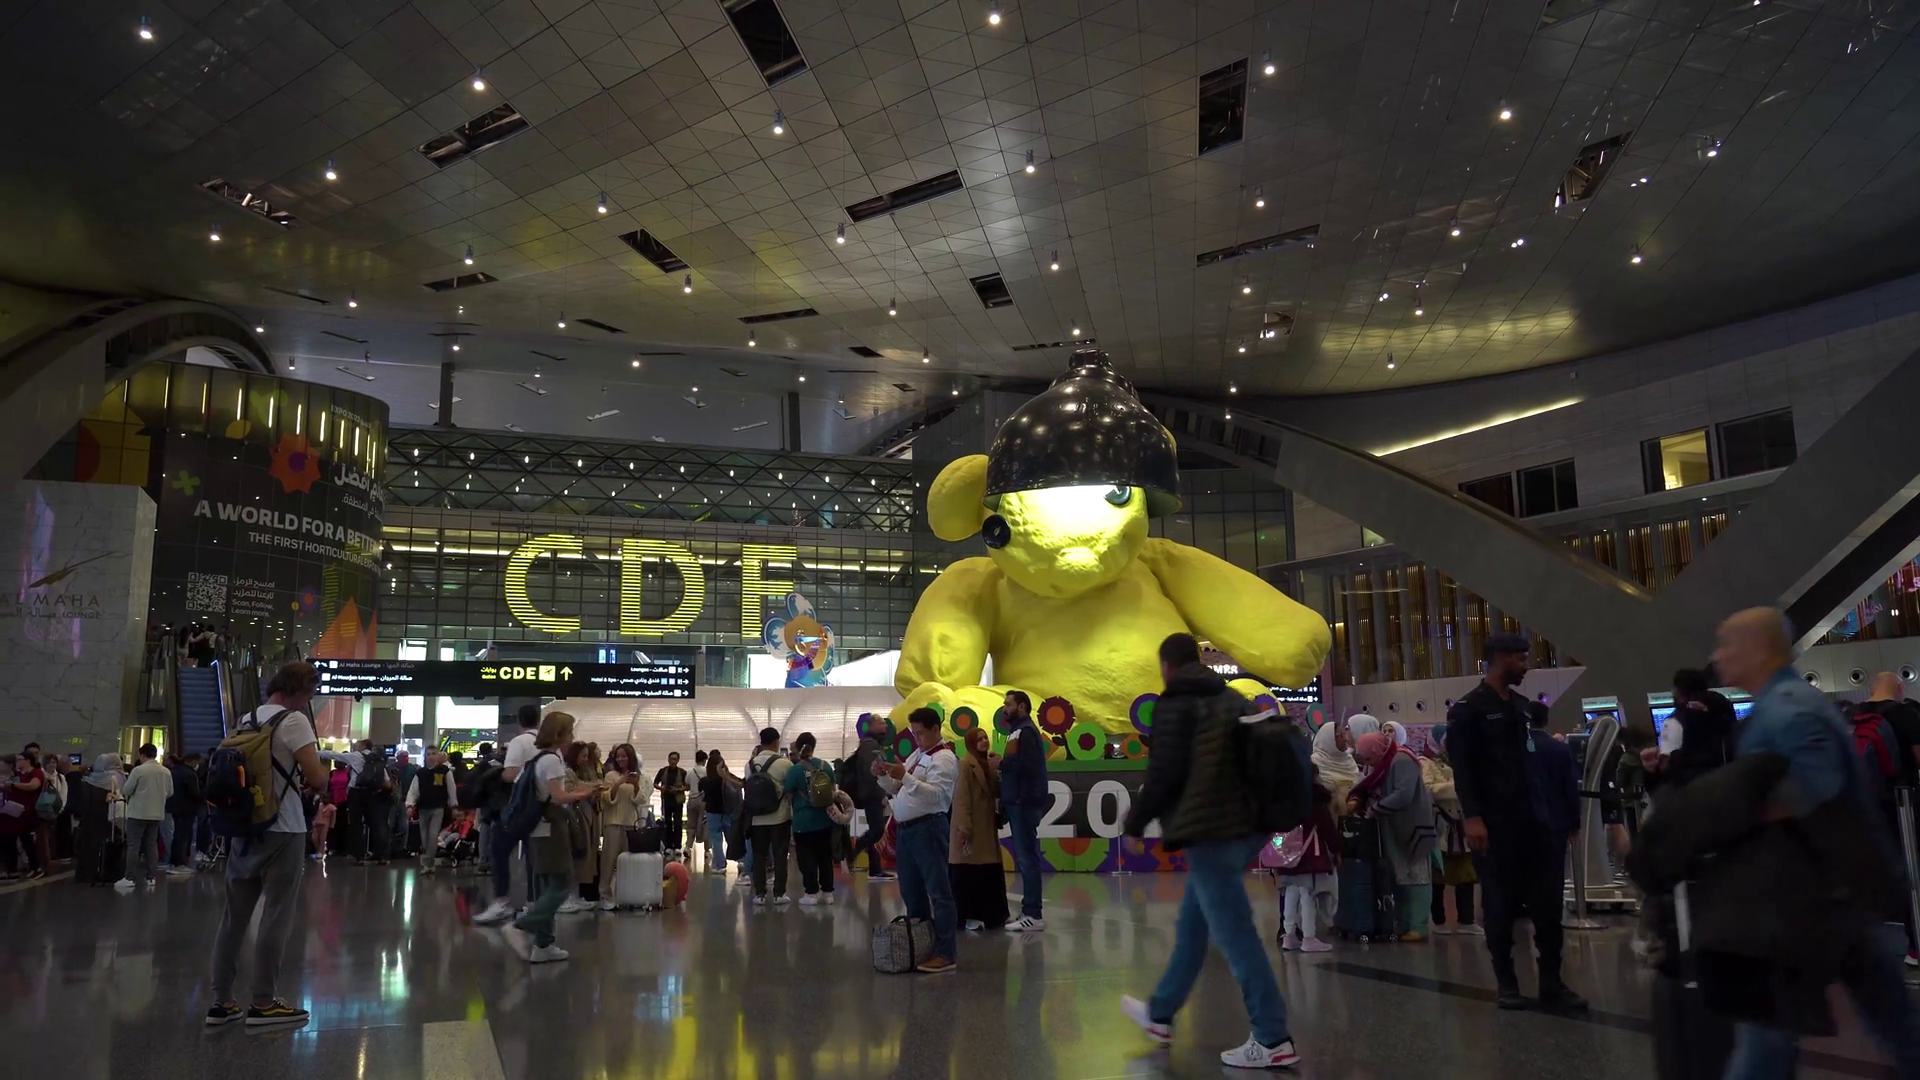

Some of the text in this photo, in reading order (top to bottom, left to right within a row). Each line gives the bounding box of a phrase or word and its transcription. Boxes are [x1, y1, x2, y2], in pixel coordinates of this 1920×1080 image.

[194, 500, 212, 518] A
[216, 502, 298, 531] WORLD
[302, 516, 336, 538] FOR
[334, 525, 345, 543] A
[249, 532, 272, 546] THE
[274, 536, 304, 551] FIRST
[305, 541, 364, 566] HORTICULTURAL
[34, 594, 100, 607] MAHA
[62, 611, 100, 619] LOUNGE
[231, 607, 250, 616] Learn
[500, 666, 536, 679] CDE
